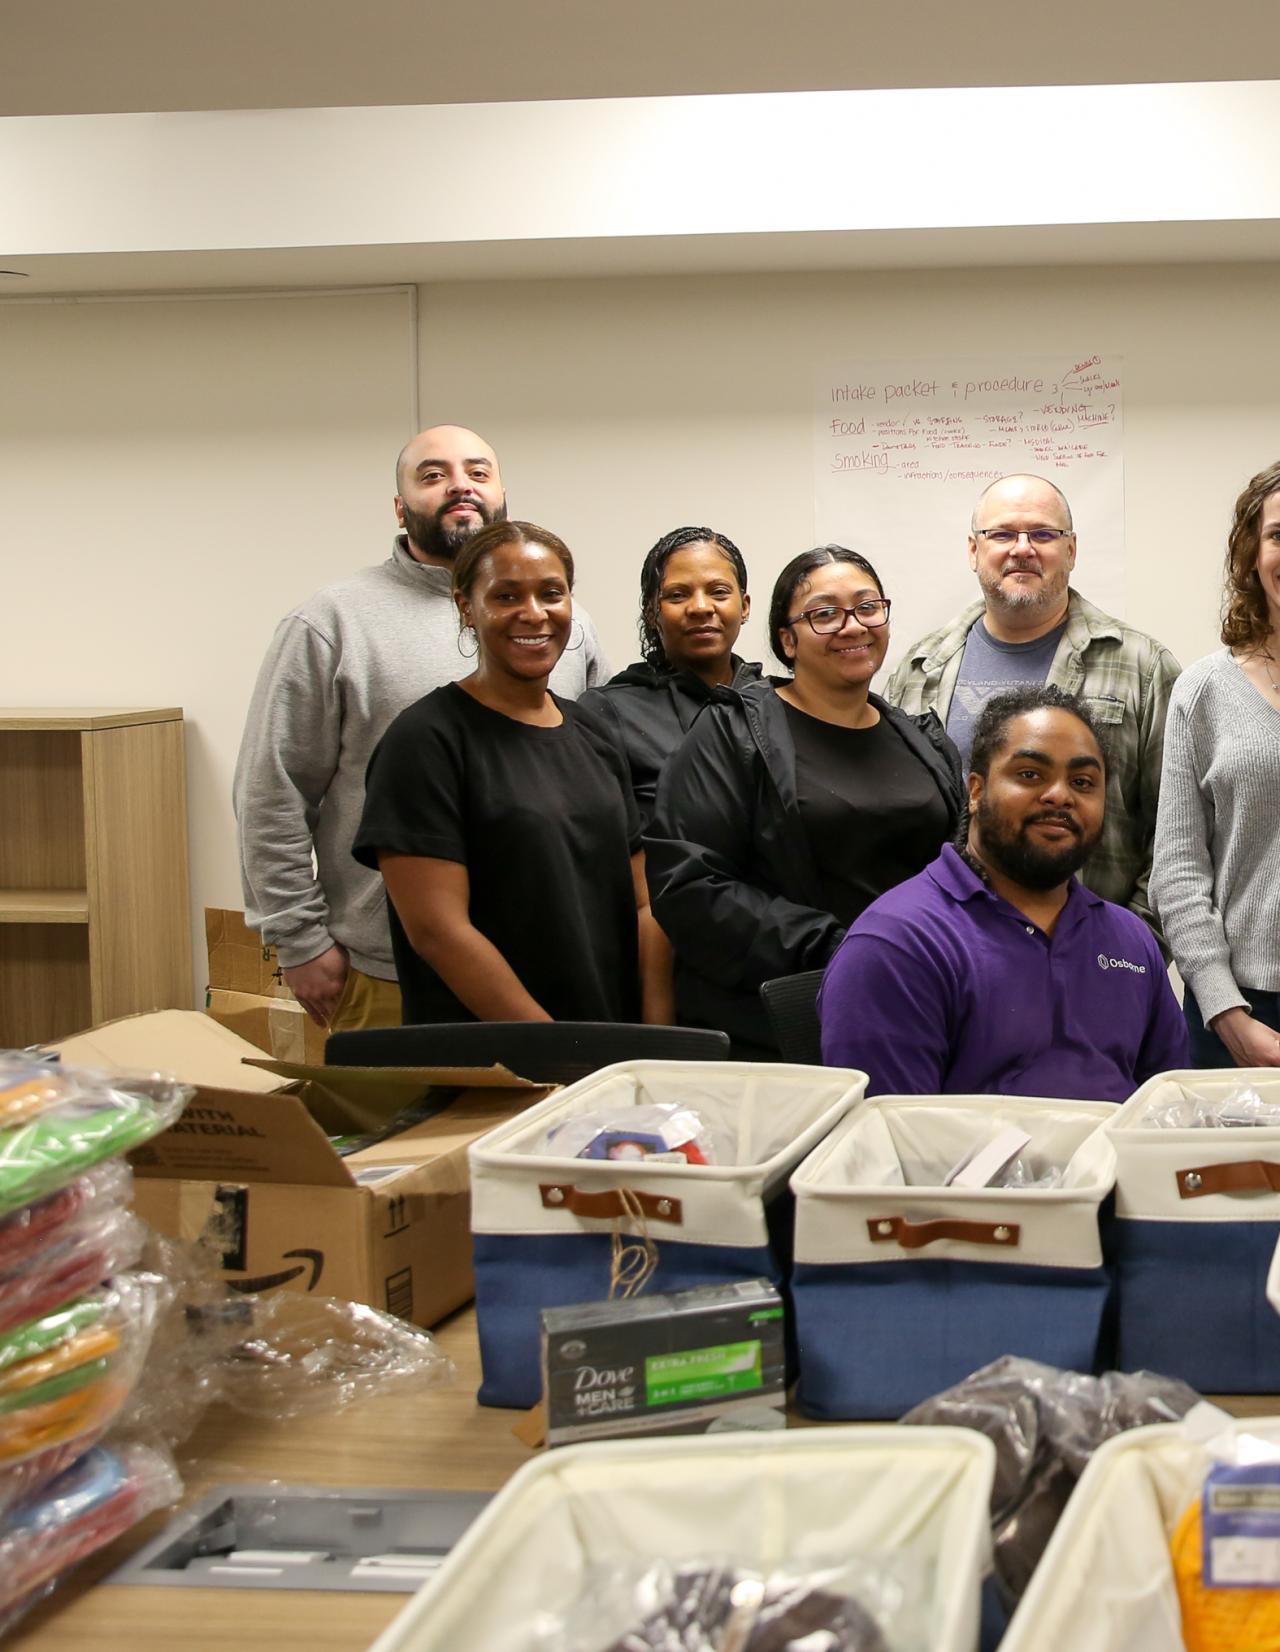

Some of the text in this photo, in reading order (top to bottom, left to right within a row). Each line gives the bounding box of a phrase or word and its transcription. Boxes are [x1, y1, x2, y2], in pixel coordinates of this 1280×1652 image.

[884, 379, 943, 404] packet
[965, 376, 1044, 400] procedure
[574, 1365, 635, 1391] Dove
[575, 1388, 616, 1406] MEN
